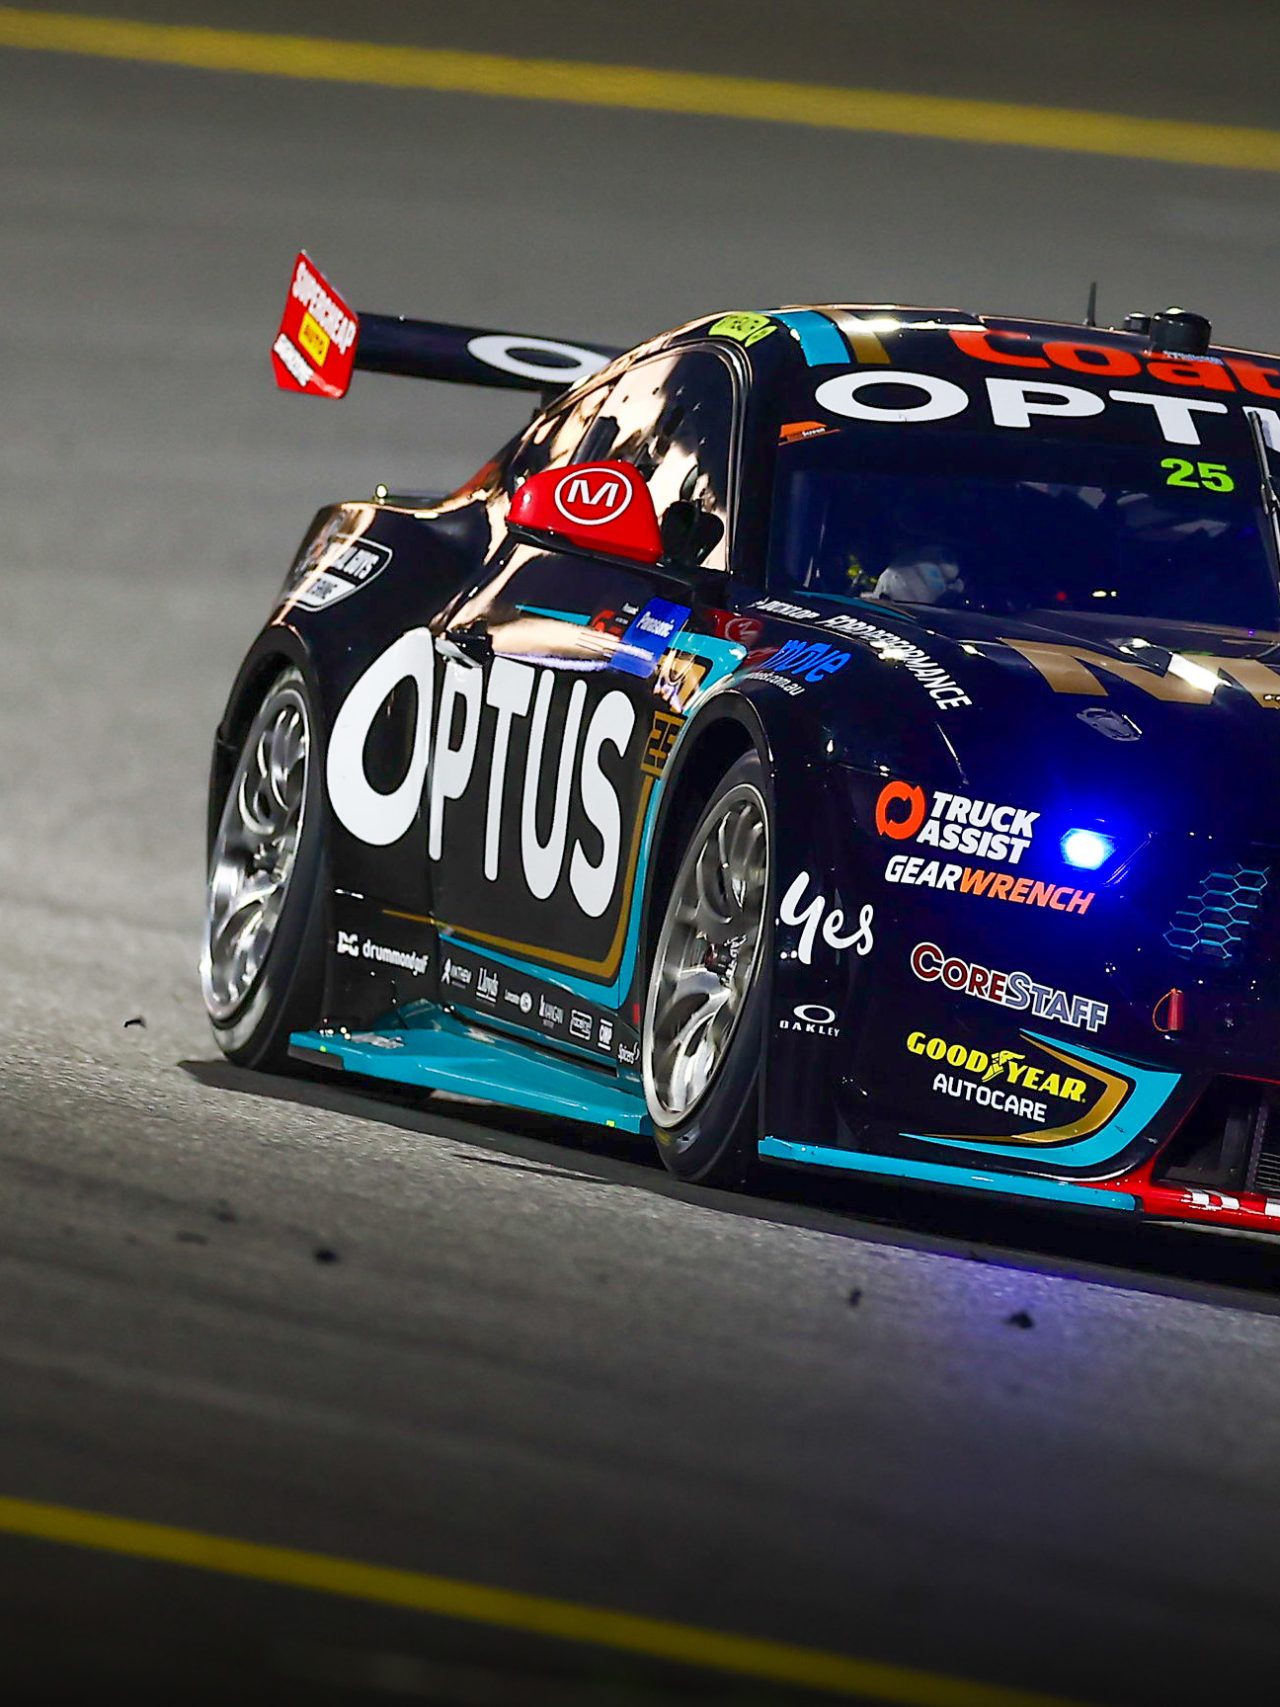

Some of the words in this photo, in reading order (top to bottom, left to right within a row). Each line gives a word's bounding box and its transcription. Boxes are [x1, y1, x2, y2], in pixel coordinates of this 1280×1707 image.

[1160, 456, 1235, 494] 25
[327, 626, 635, 917] OPTUS
[928, 791, 1041, 839] TRUCK
[916, 820, 1031, 865] ASSIST
[884, 854, 1096, 916] GEARWRENCH
[779, 1020, 841, 1037] OAKLEY
[932, 1072, 1048, 1122] AUTOCARE
